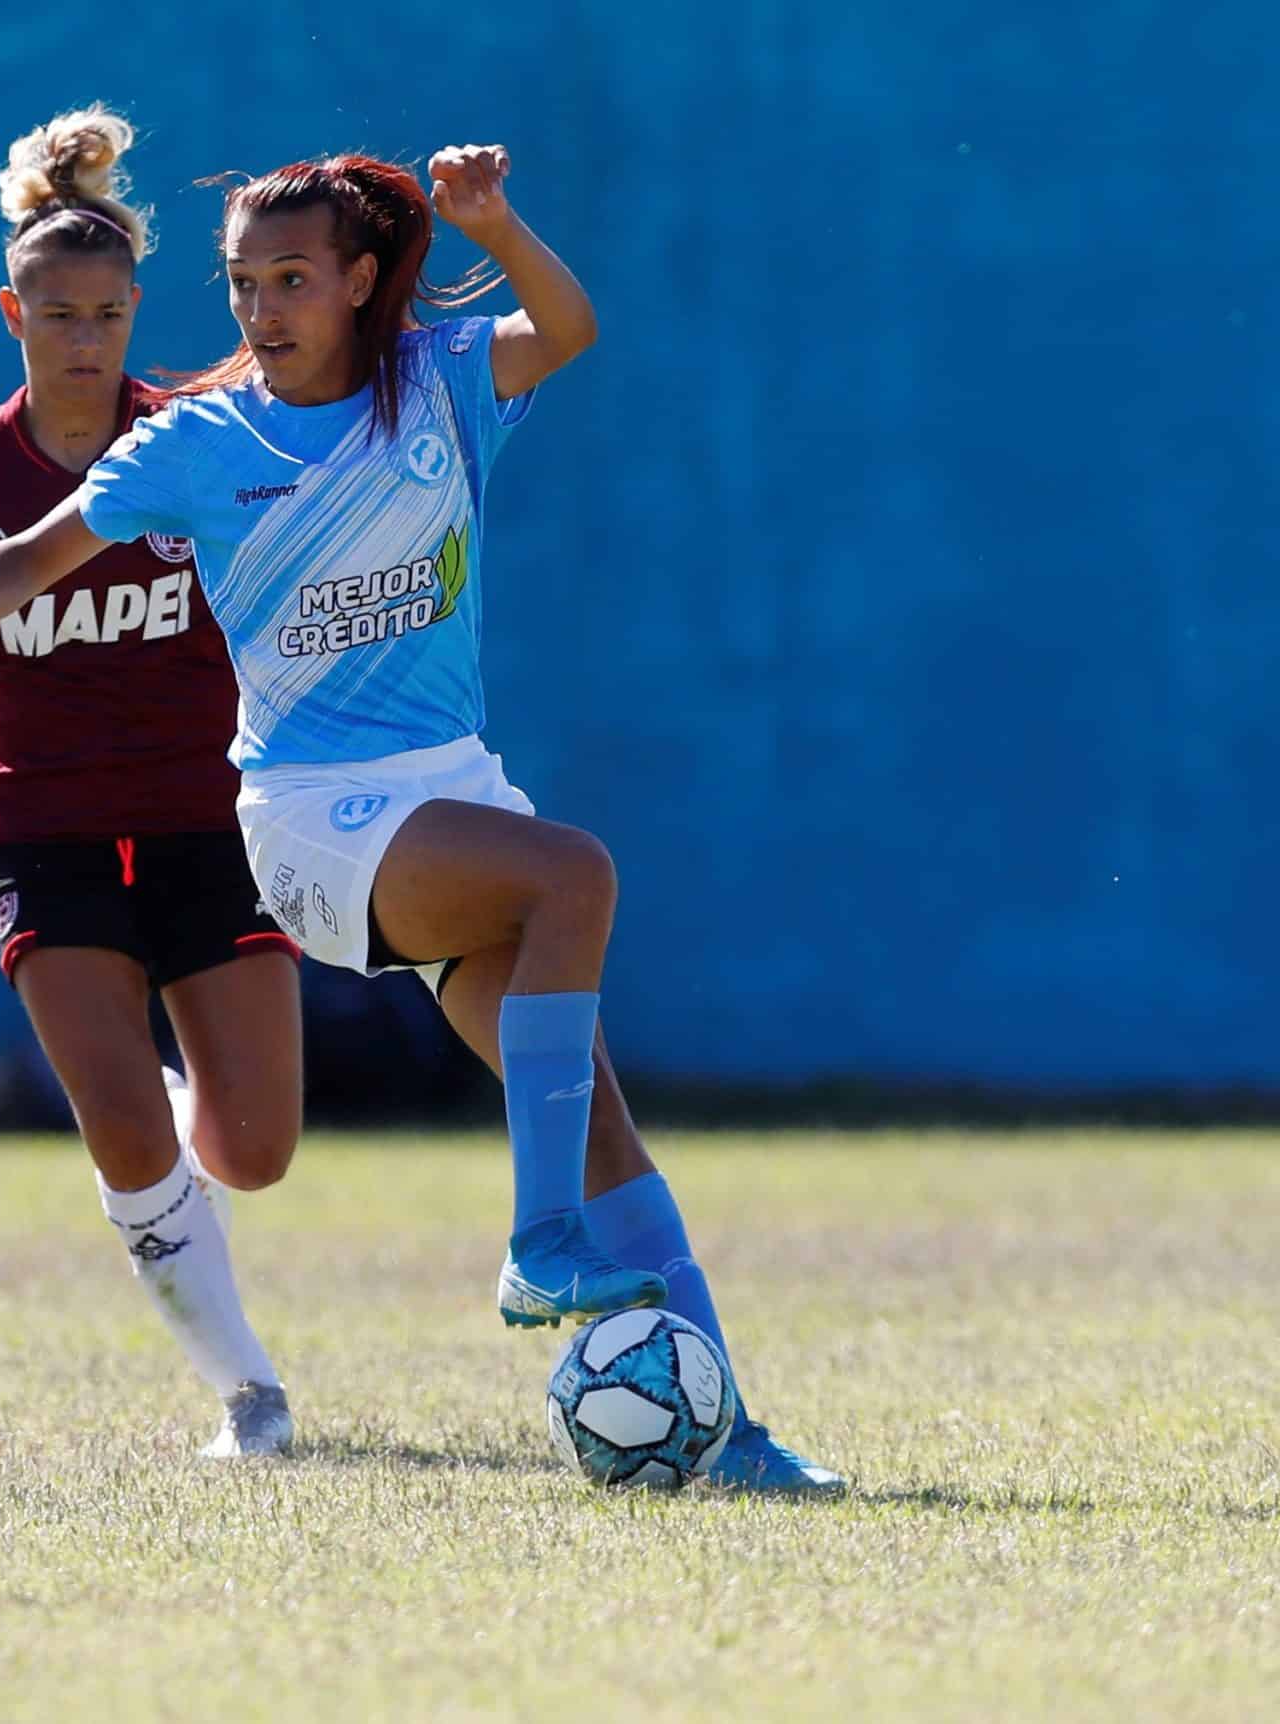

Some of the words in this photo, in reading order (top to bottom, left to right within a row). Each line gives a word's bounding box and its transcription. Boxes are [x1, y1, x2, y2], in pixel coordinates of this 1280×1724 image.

[234, 484, 299, 508] HighRunner
[0, 569, 193, 658] MAPEI
[300, 557, 434, 618] MEJOR
[278, 597, 435, 657] CRÉDITO
